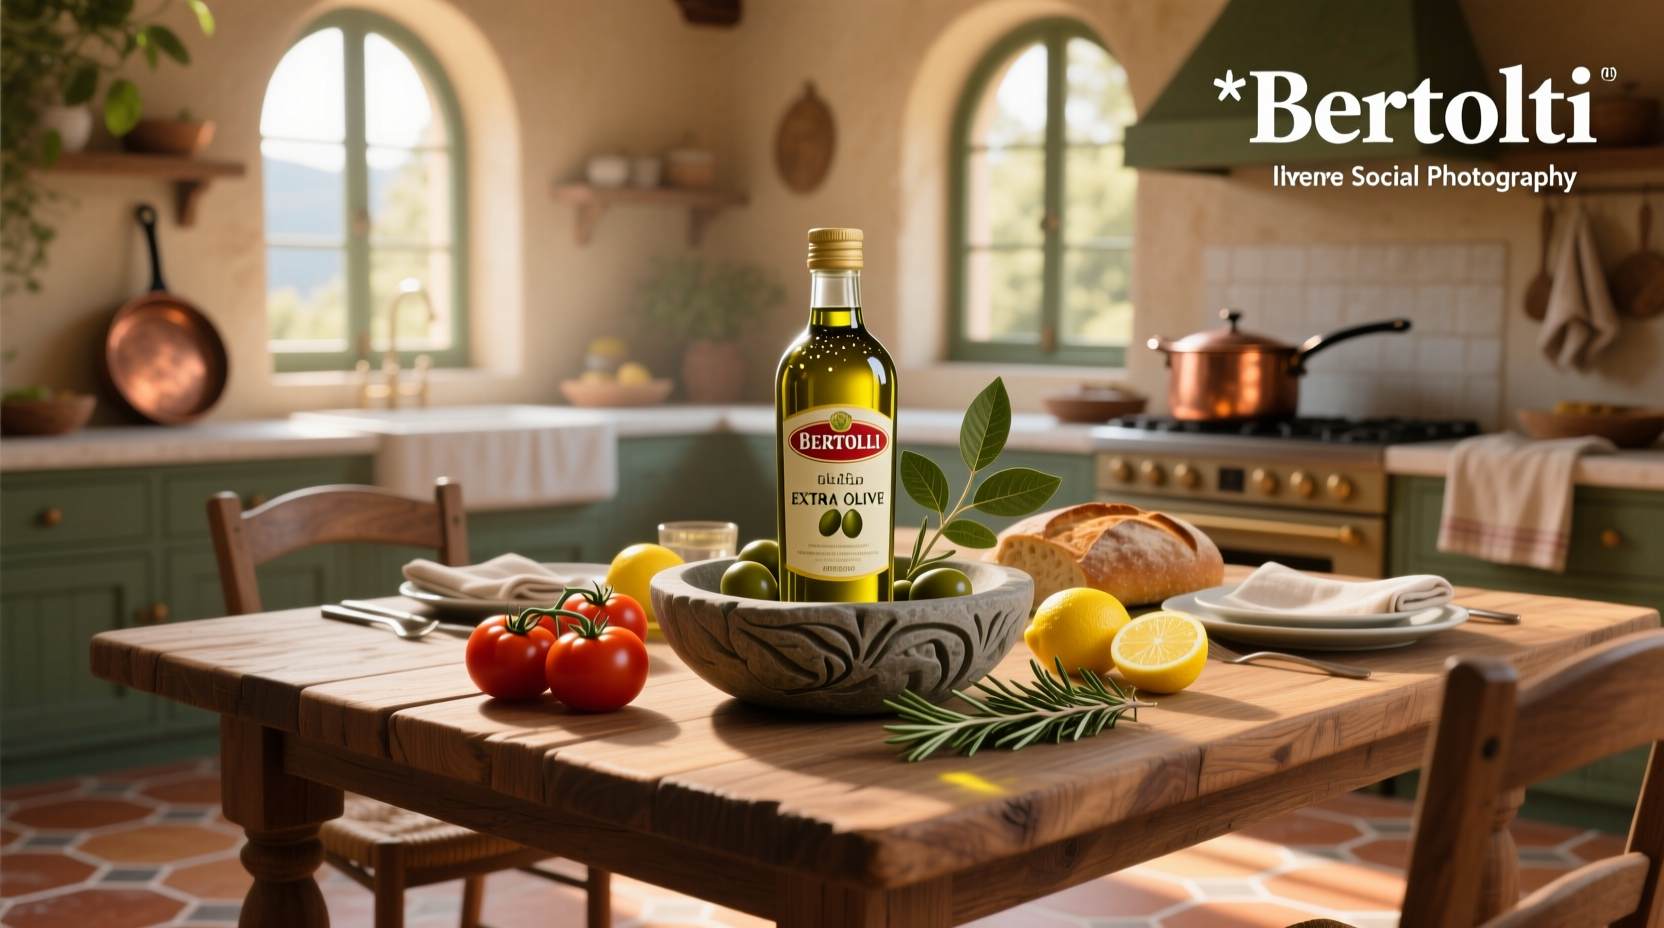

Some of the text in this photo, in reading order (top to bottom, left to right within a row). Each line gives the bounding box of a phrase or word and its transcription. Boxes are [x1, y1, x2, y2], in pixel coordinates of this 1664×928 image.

[799, 431, 881, 450] BERTOLLI
[791, 491, 885, 506] EXTRA OLIVE
